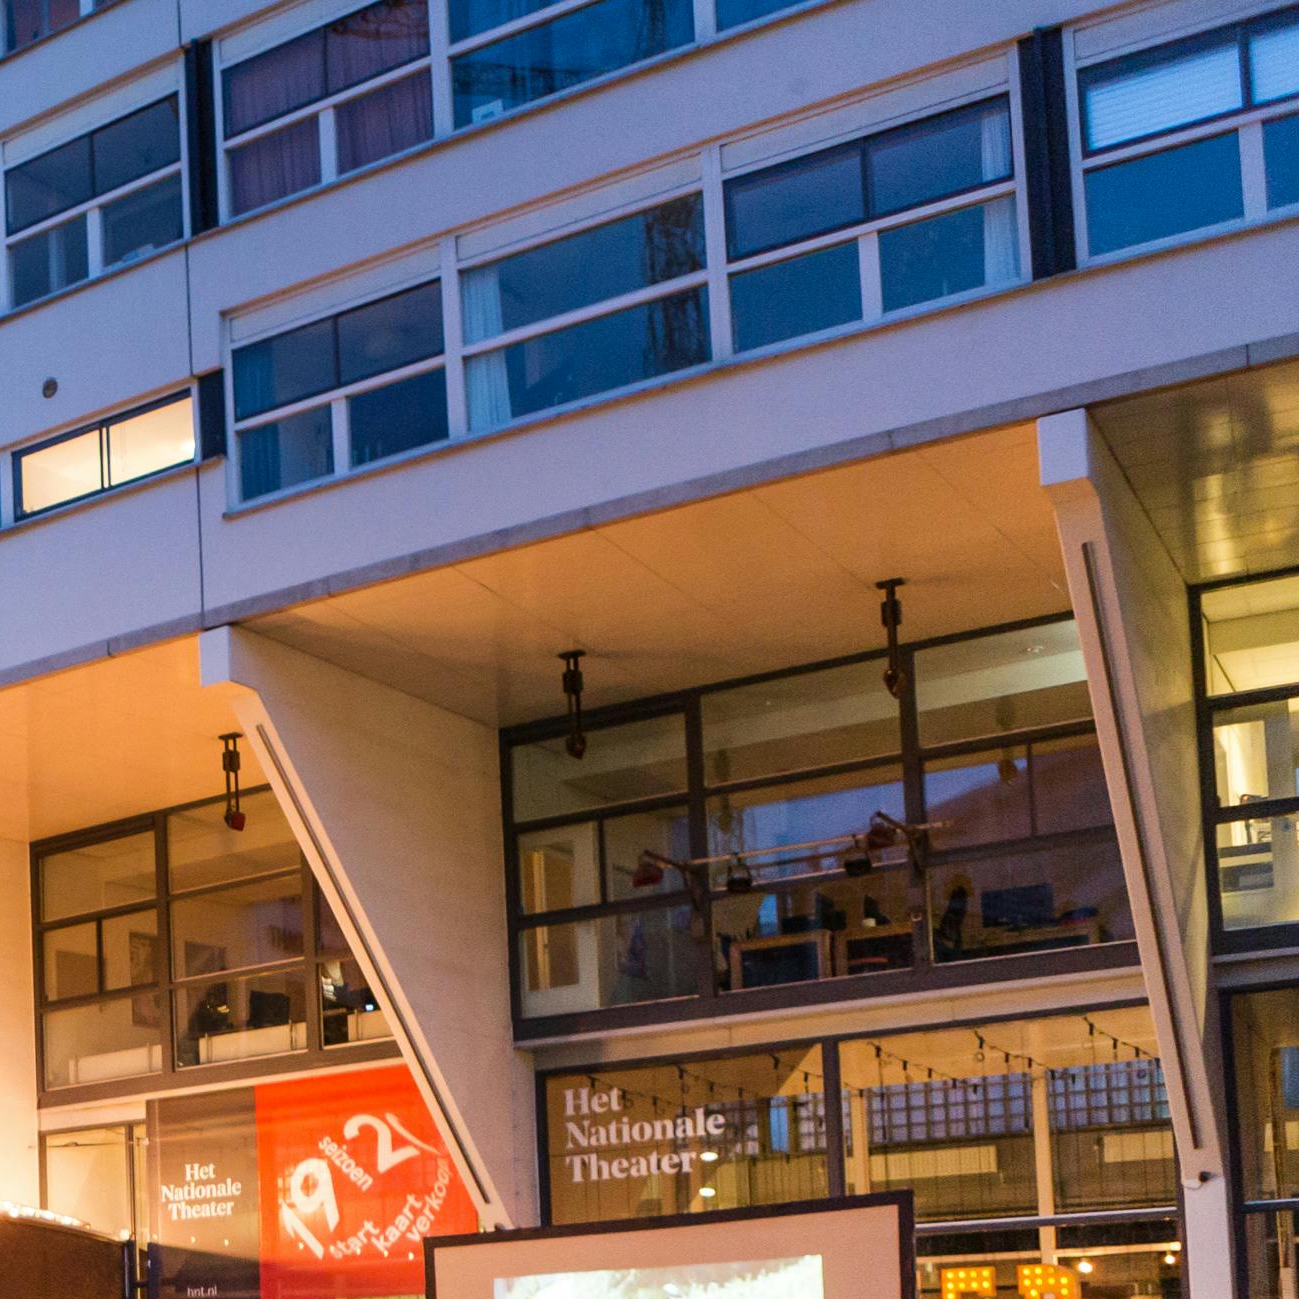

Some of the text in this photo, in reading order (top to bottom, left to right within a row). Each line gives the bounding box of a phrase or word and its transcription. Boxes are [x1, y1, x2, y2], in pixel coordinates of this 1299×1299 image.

[563, 1087, 623, 1117] Het
[565, 1107, 727, 1149] Nationale
[185, 1163, 216, 1181] Het
[318, 1136, 374, 1192] seizoen
[565, 1150, 699, 1183] Theater
[161, 1178, 242, 1202] Nationale
[168, 1201, 234, 1220] Theater
[371, 1194, 423, 1252] kaart
[330, 1219, 381, 1259] start
[187, 1285, 218, 1298] hnt.nl
